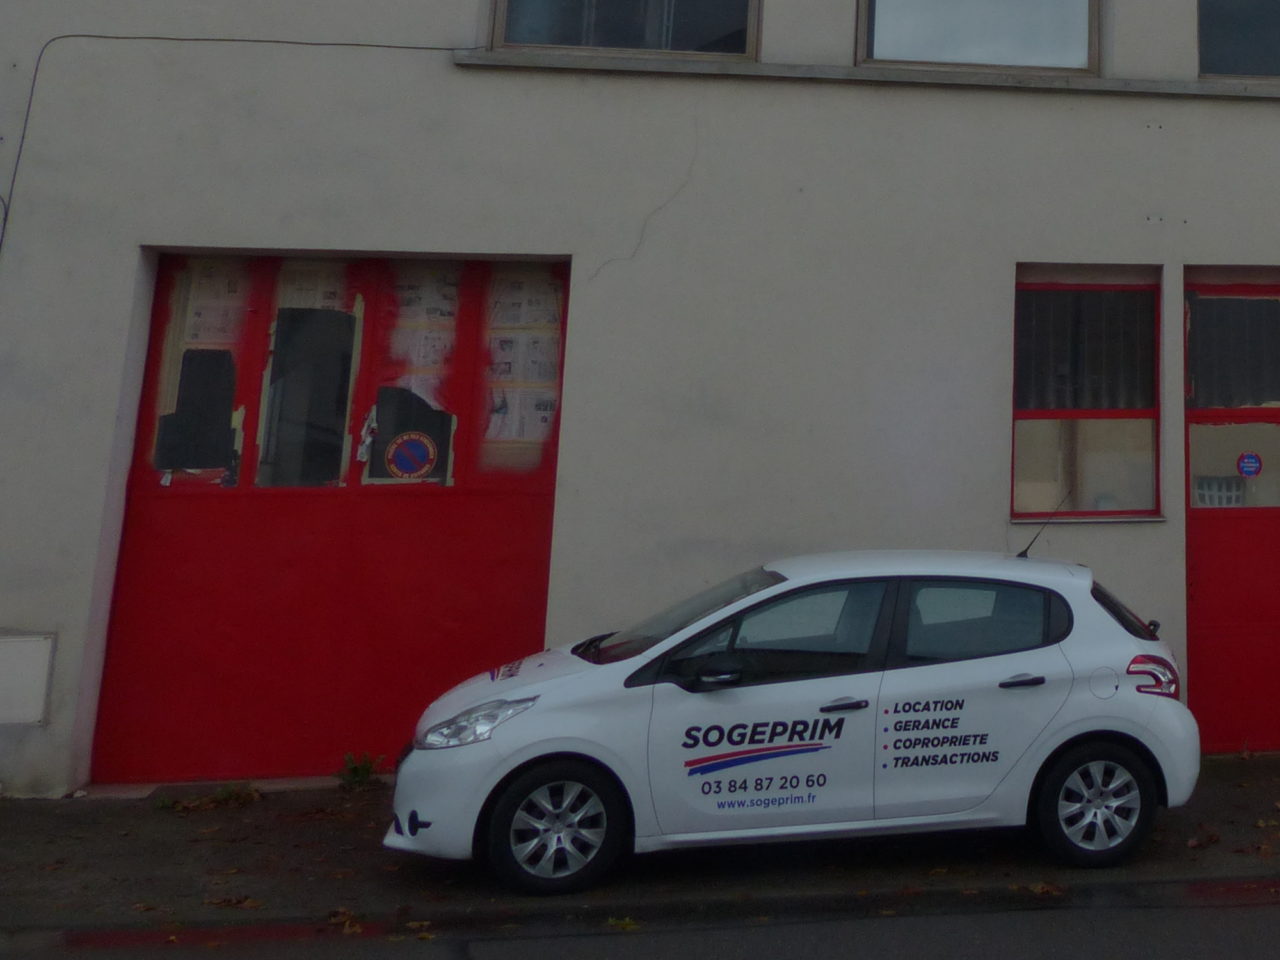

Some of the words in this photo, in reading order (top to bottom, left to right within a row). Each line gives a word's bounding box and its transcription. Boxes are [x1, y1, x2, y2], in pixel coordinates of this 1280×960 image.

[893, 699, 965, 714] LOCATION
[681, 717, 845, 750] SOGEPRIM
[893, 717, 960, 732] GERANCE
[892, 733, 989, 751] COPROPRIETE
[892, 751, 1000, 768] TRANSACTIONS
[701, 780, 723, 795] 03
[728, 779, 749, 794] 84
[753, 777, 774, 792] 87
[779, 775, 801, 790] 20
[805, 773, 828, 789] 60
[716, 792, 818, 810] www.sogeprim.fr
